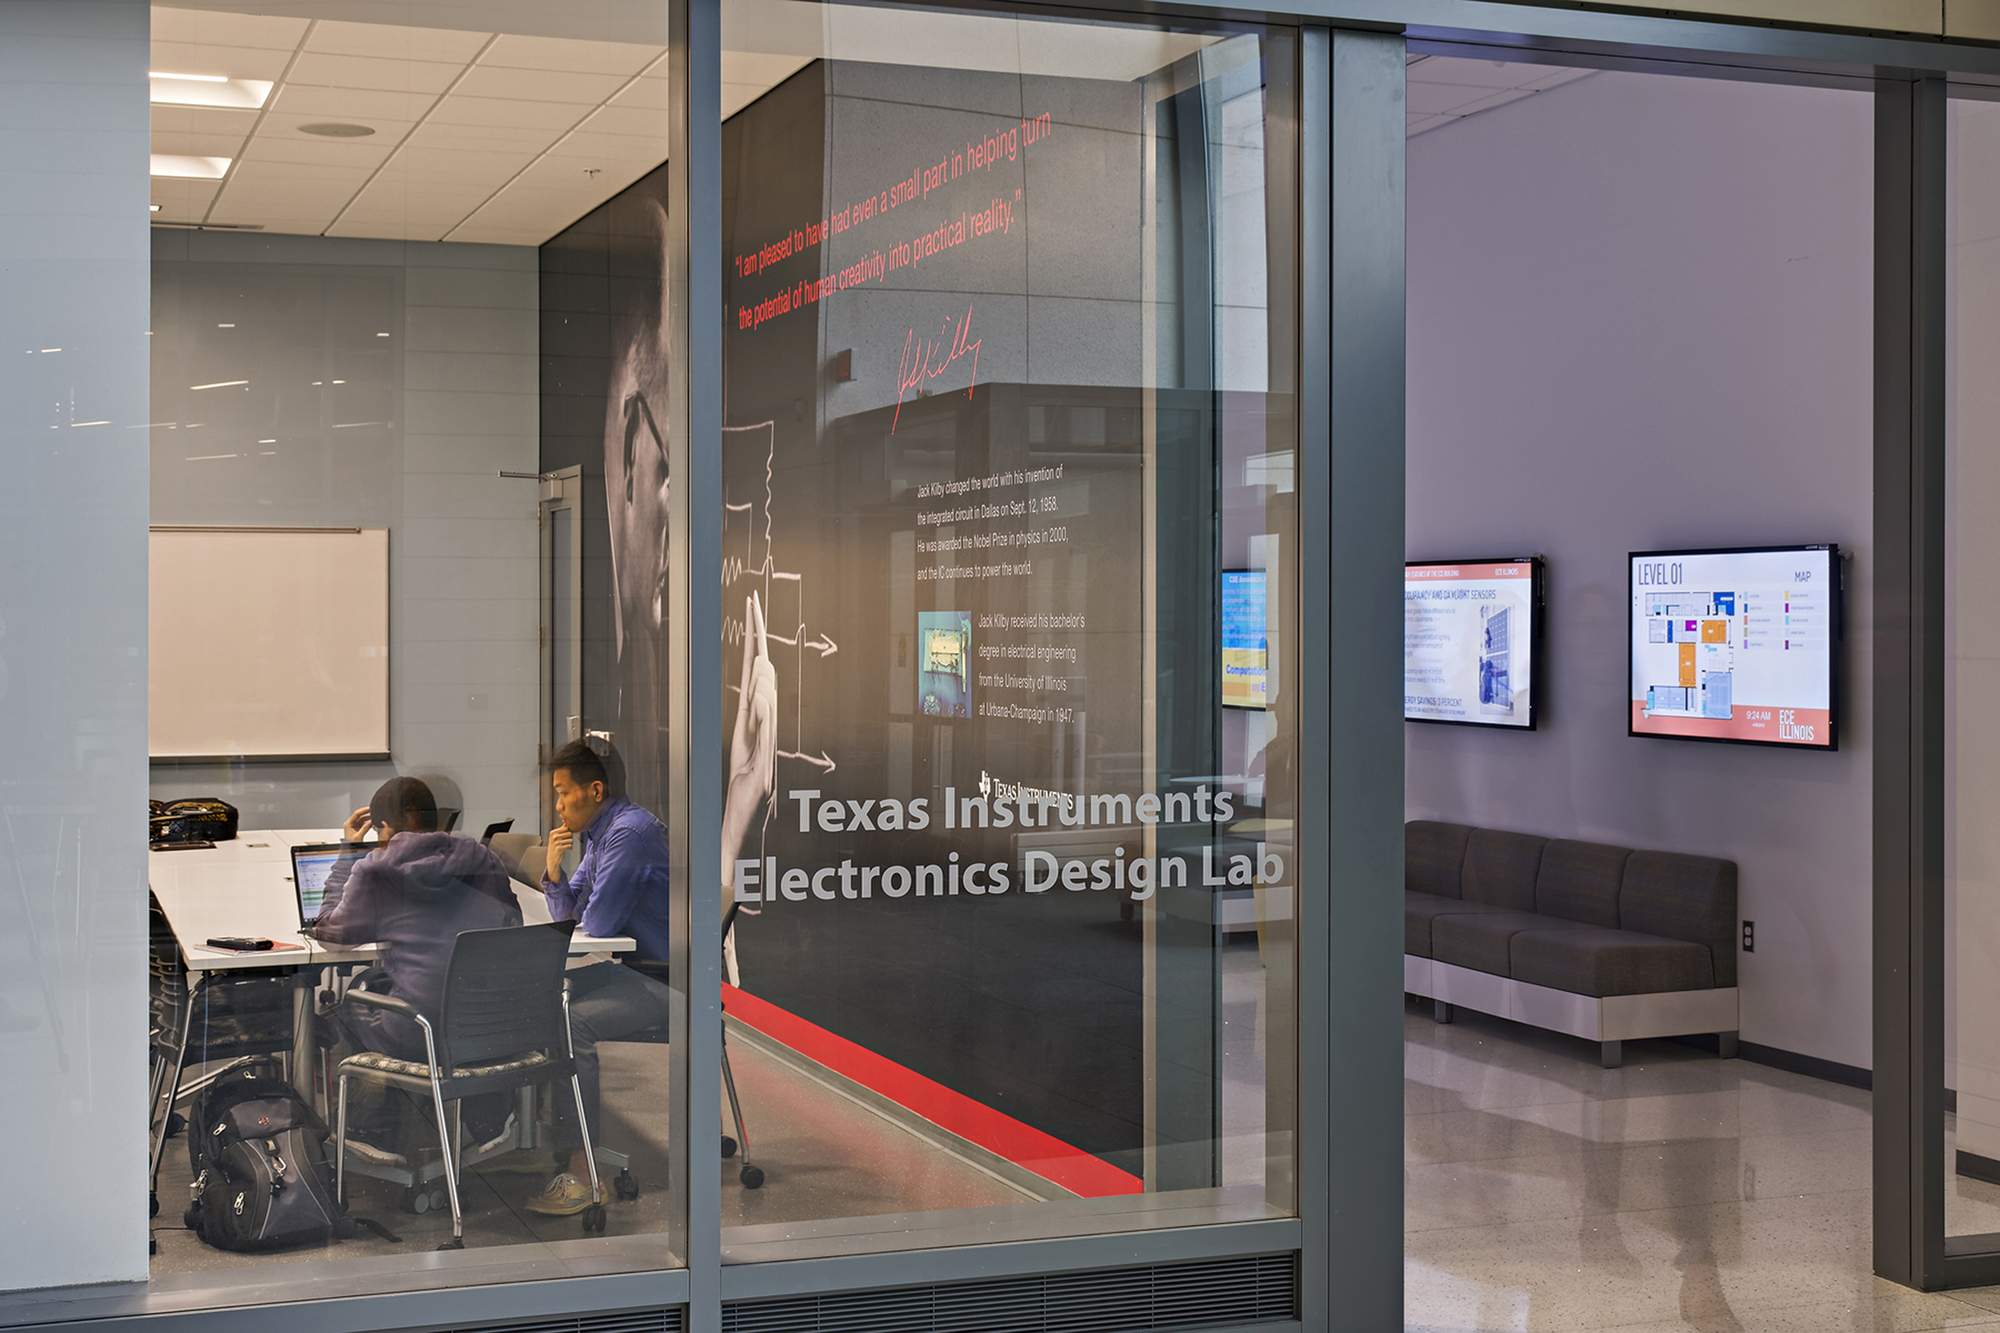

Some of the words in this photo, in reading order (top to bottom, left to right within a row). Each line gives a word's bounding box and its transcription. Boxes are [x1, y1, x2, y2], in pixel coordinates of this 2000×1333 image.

[744, 255, 757, 276] am
[759, 229, 792, 275] pleased
[794, 229, 804, 251] to
[806, 219, 829, 247] have
[831, 202, 850, 235] had
[853, 195, 877, 224] even
[881, 191, 887, 212] a
[890, 168, 920, 208] small
[924, 159, 947, 199] part
[951, 150, 962, 179] in
[967, 127, 1017, 171] helping
[1022, 112, 1050, 147] turn
[739, 305, 752, 330] the
[754, 286, 791, 330] potential
[793, 281, 802, 309] of
[804, 273, 836, 303] human
[839, 243, 886, 291] creativity
[889, 241, 910, 271] into
[913, 212, 966, 268] practical
[917, 484, 930, 498] Jack
[931, 482, 945, 497] Kilby
[946, 479, 970, 496] changed
[971, 478, 981, 490] the
[982, 473, 999, 488] world
[1000, 471, 1013, 486] with
[1014, 469, 1024, 484] his
[1025, 466, 1054, 482] invention
[1055, 464, 1063, 479] of
[918, 512, 926, 525] the
[927, 508, 954, 526] integrated
[955, 507, 973, 521] circuit
[974, 506, 980, 519] in
[981, 503, 999, 518] Dallas
[1001, 504, 1009, 516] on
[1010, 500, 1026, 517] Sept.
[1028, 499, 1038, 514] 12,
[918, 540, 925, 552] He
[926, 540, 937, 551] was
[938, 535, 962, 551] awarded
[963, 535, 972, 549] the
[973, 533, 991, 548] Nobel
[993, 533, 1008, 546] Prize
[1009, 532, 1015, 545] in
[1016, 530, 1040, 548] physics
[1042, 529, 1048, 542] in
[918, 567, 927, 580] and
[929, 567, 937, 579] the
[938, 565, 945, 579] IC
[946, 565, 973, 578] continues
[975, 563, 981, 577] to
[982, 563, 1000, 579] power
[1002, 562, 1012, 575] the
[1013, 561, 1032, 575] world.
[1638, 563, 1668, 585] LEVEL
[1671, 563, 1682, 584] 01
[1795, 571, 1811, 582] MAP
[1471, 589, 1496, 600] SENSORS
[978, 614, 993, 628] Jack
[994, 614, 1009, 631] Kilby
[1011, 614, 1038, 628] received
[1038, 614, 1048, 628] his
[979, 643, 999, 660] degree
[1001, 644, 1007, 658] in
[1008, 644, 1036, 658] electrical
[1037, 645, 1077, 663] engineering
[979, 673, 993, 688] from
[994, 674, 1004, 688] the
[1005, 674, 1036, 692] University
[1037, 675, 1044, 689] of
[1045, 675, 1067, 691] Illinois
[979, 705, 985, 716] at
[986, 703, 1046, 724] Urbana-Champaign
[1047, 707, 1054, 721] in
[1746, 711, 1759, 719] 9:24
[1760, 711, 1771, 720] AM
[1780, 710, 1794, 724] ECE
[1780, 725, 1814, 740] ILLINOIS
[993, 779, 1016, 800] TEXAS
[1018, 782, 1073, 810] ITRUMES
[789, 788, 929, 833] Texas
[945, 783, 1234, 829] Instruments
[734, 851, 1010, 902] Electronics
[1024, 847, 1187, 900] Design
[1202, 842, 1284, 886] Lab
